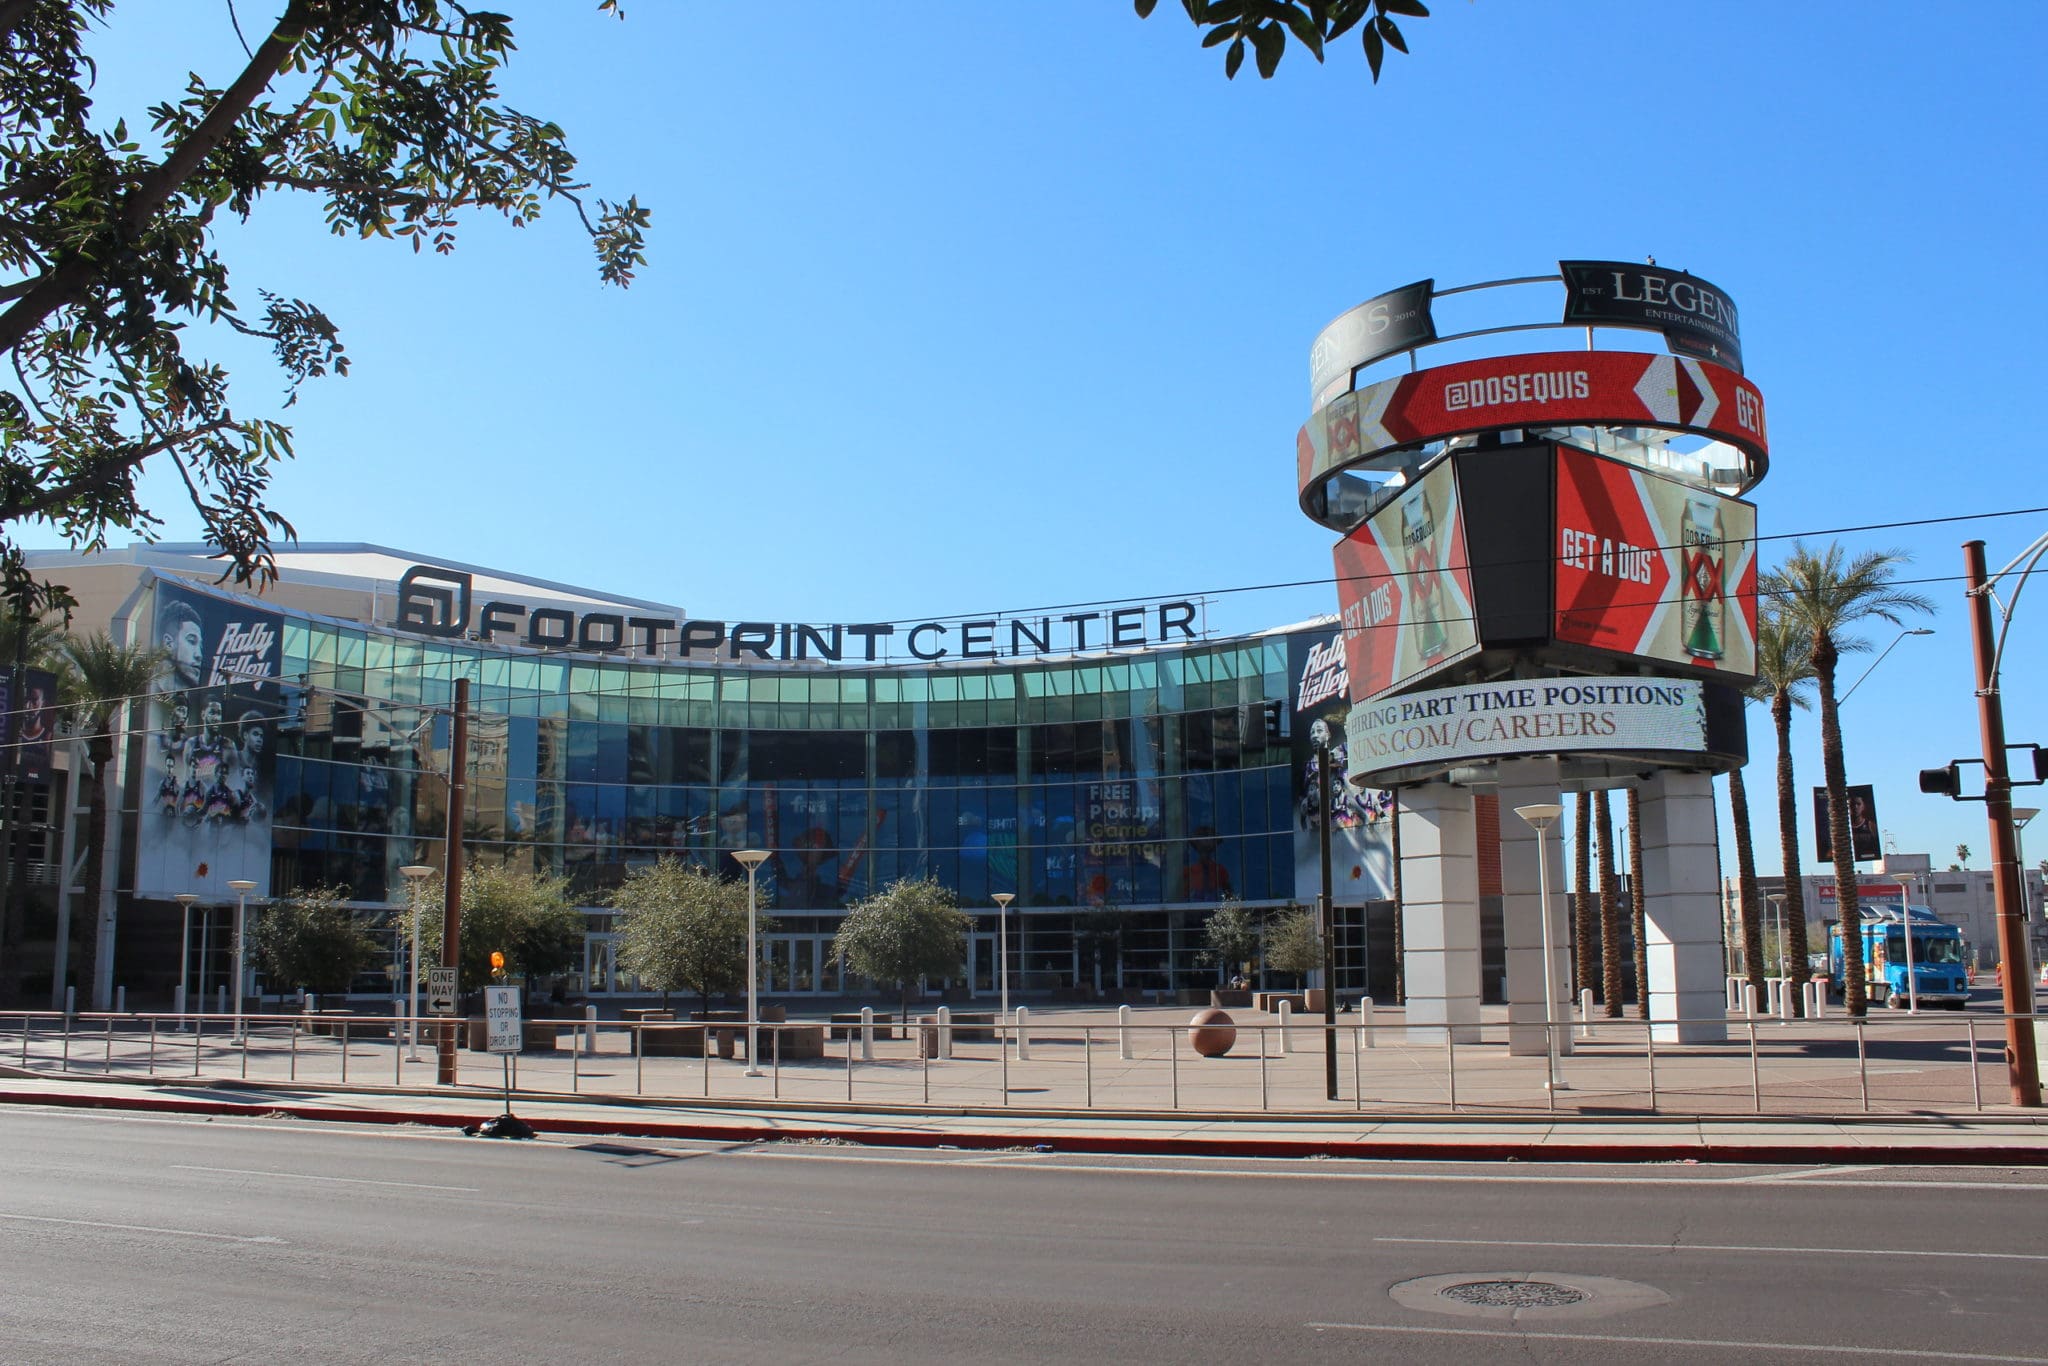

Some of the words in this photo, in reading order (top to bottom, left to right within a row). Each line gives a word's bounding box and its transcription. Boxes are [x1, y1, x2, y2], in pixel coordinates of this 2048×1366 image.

[1394, 310, 1416, 322] 2010
[1645, 308, 1725, 339] ENTERTAINMENT
[1445, 370, 1590, 411] @DOSEQUIS
[1735, 386, 1761, 437] GET
[1562, 527, 1597, 572] GET
[1602, 537, 1613, 577] A
[479, 603, 894, 663] FOOTPRINT
[907, 602, 1199, 661] CENTER
[1344, 601, 1363, 641] GET
[1362, 593, 1373, 630] A
[215, 622, 276, 660] Rally
[1296, 667, 1350, 712] Valley
[1401, 695, 1457, 722] PART
[1463, 687, 1536, 712] TIME
[1544, 685, 1684, 707] POSITIONS
[1353, 711, 1616, 764] SUNS.COM/CAREERS
[1090, 784, 1131, 800] FREE
[431, 971, 454, 983] ONE
[431, 985, 454, 997] WAY
[489, 1007, 519, 1019] STOPPING
[498, 992, 509, 1005] NO
[489, 1034, 507, 1048] DROP
[508, 1034, 520, 1046] OFF
[500, 1021, 509, 1033] OR
